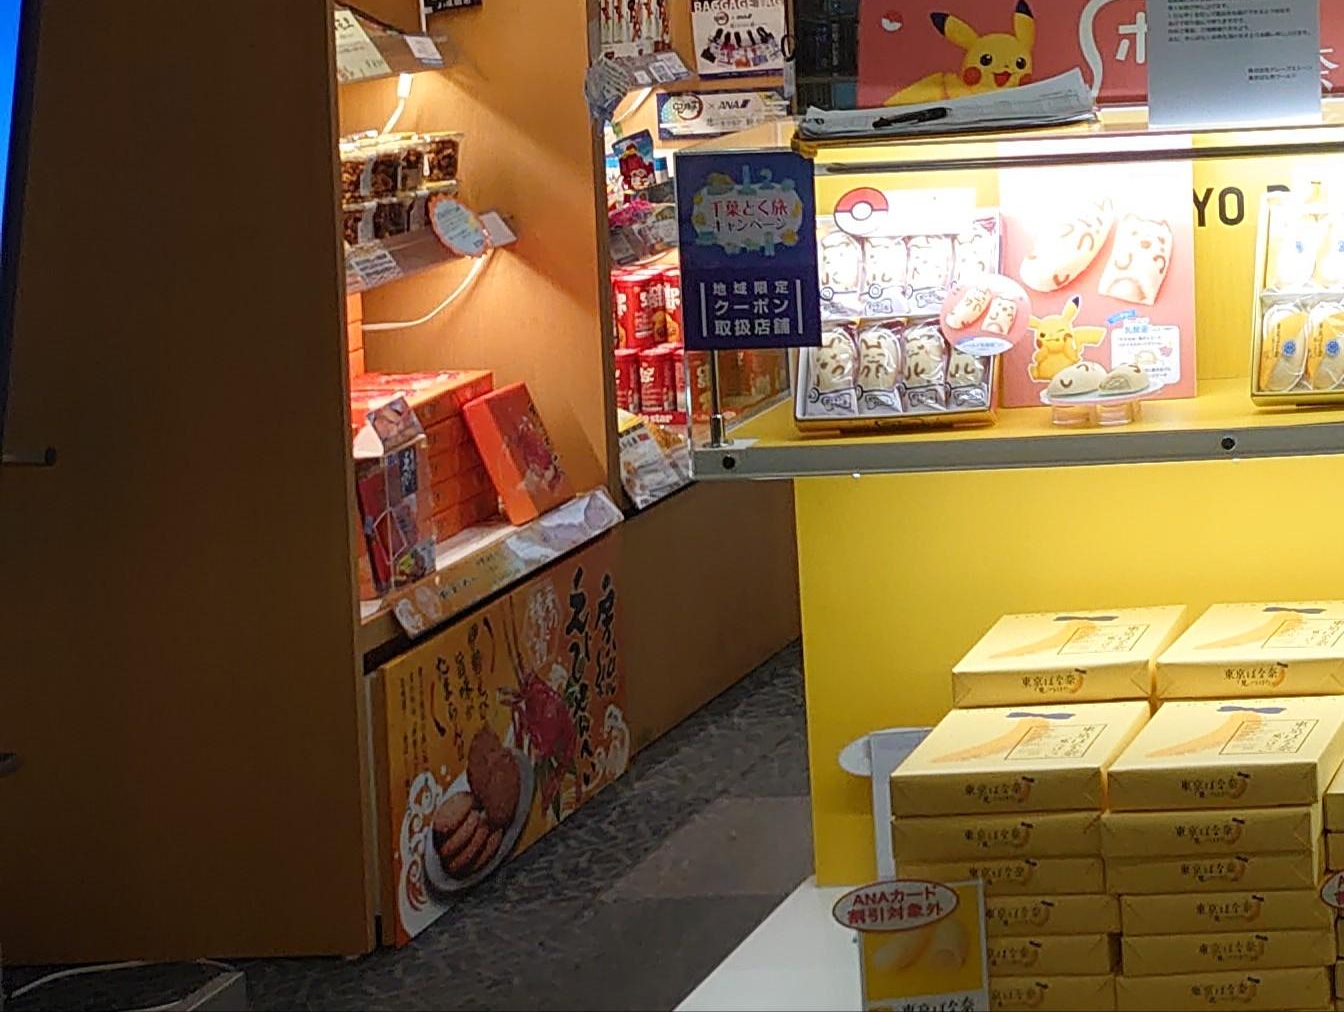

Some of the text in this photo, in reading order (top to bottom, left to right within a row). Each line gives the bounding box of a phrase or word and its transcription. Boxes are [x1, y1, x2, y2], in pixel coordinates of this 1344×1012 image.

[718, 99, 741, 111] ANA
[711, 199, 788, 216] 千葉とく旅
[713, 218, 786, 231] キャンペーン
[711, 281, 790, 296] 地域限定
[713, 299, 790, 316] クーポン
[714, 319, 791, 336] 取扱店舗
[1021, 672, 1075, 689] 東京ばな奈
[1224, 668, 1278, 682] 東京ばな奈
[853, 885, 937, 906] ANAカード
[848, 903, 943, 925] 割引対象外
